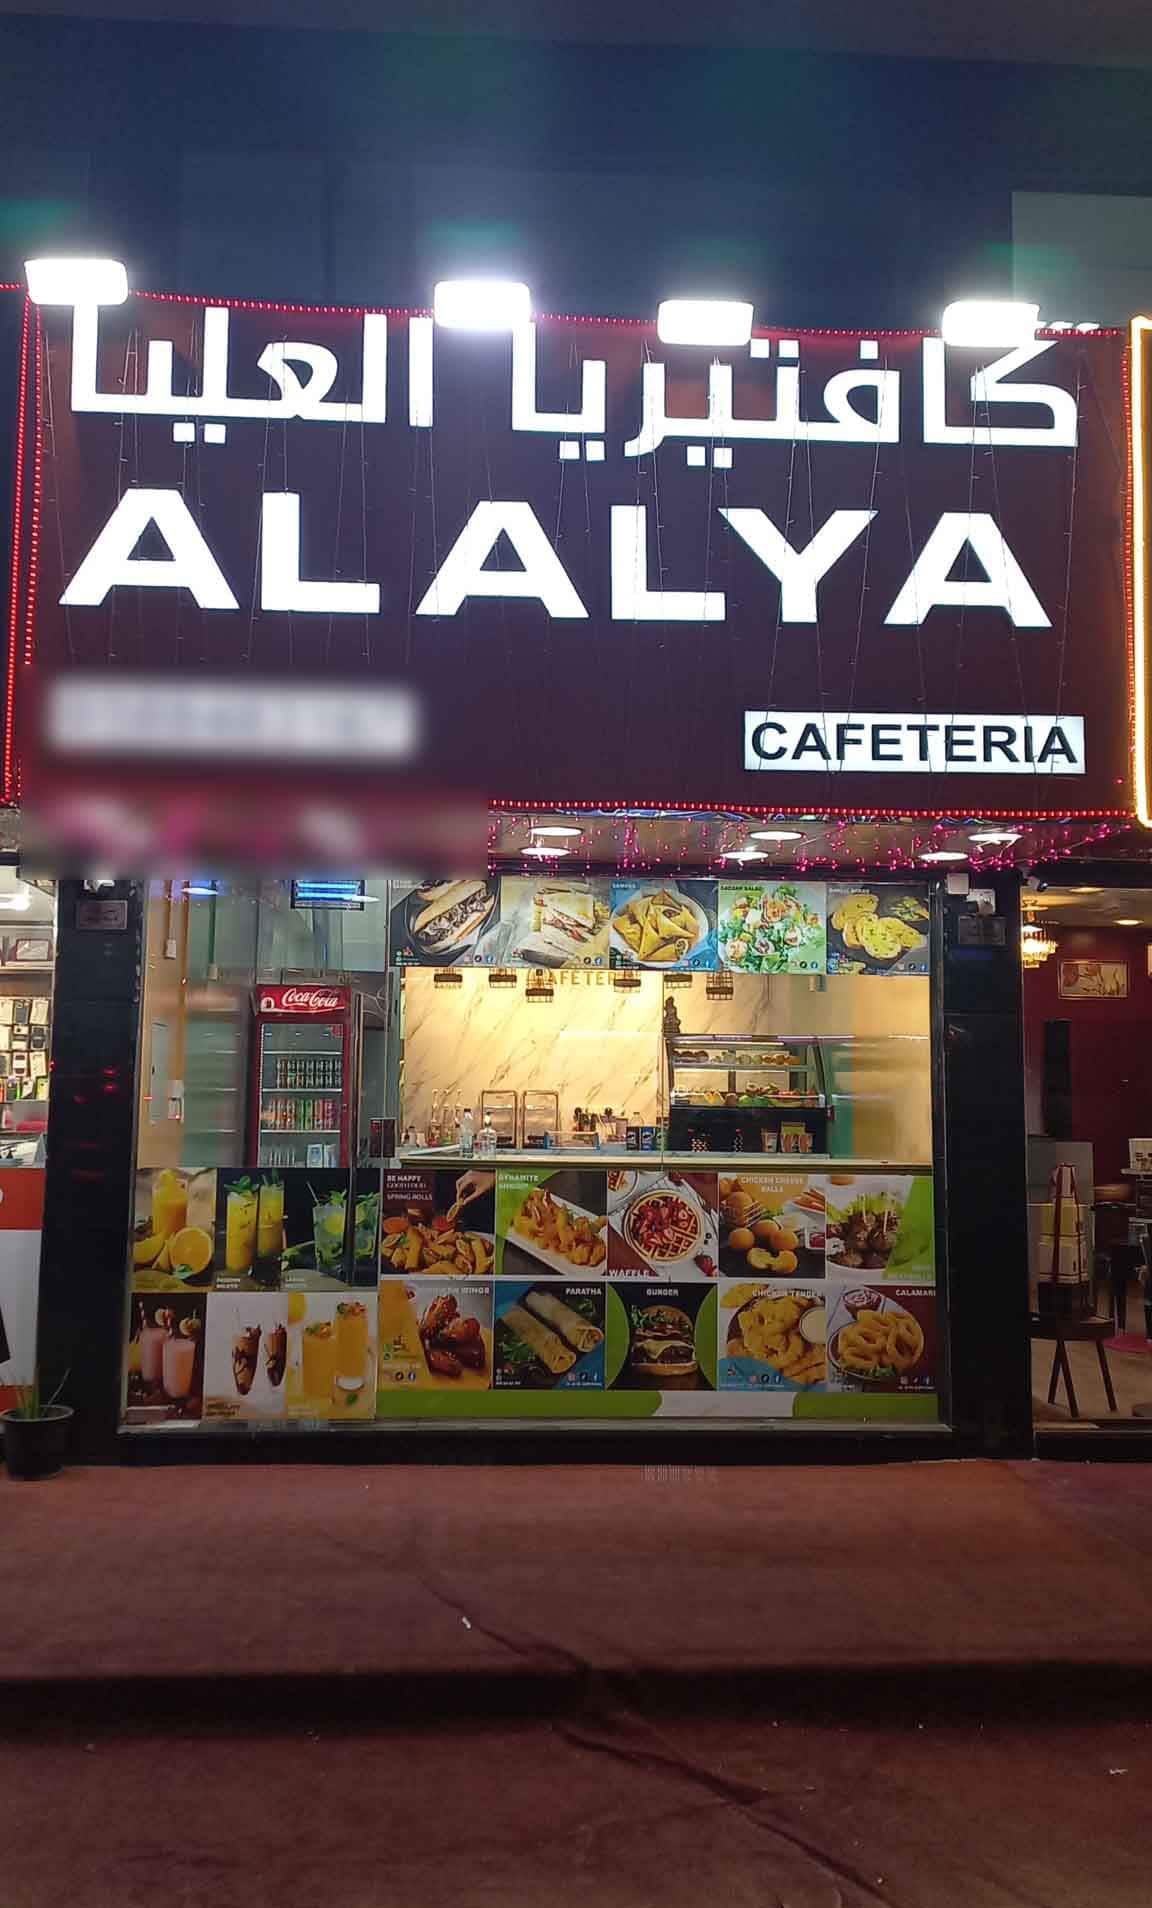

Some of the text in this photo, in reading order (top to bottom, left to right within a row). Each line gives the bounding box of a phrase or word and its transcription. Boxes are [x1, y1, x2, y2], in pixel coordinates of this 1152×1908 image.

[71, 303, 1079, 469] كافتيريا العليا
[58, 487, 1054, 630] ALALYA
[750, 720, 1079, 764] CAFETERIA
